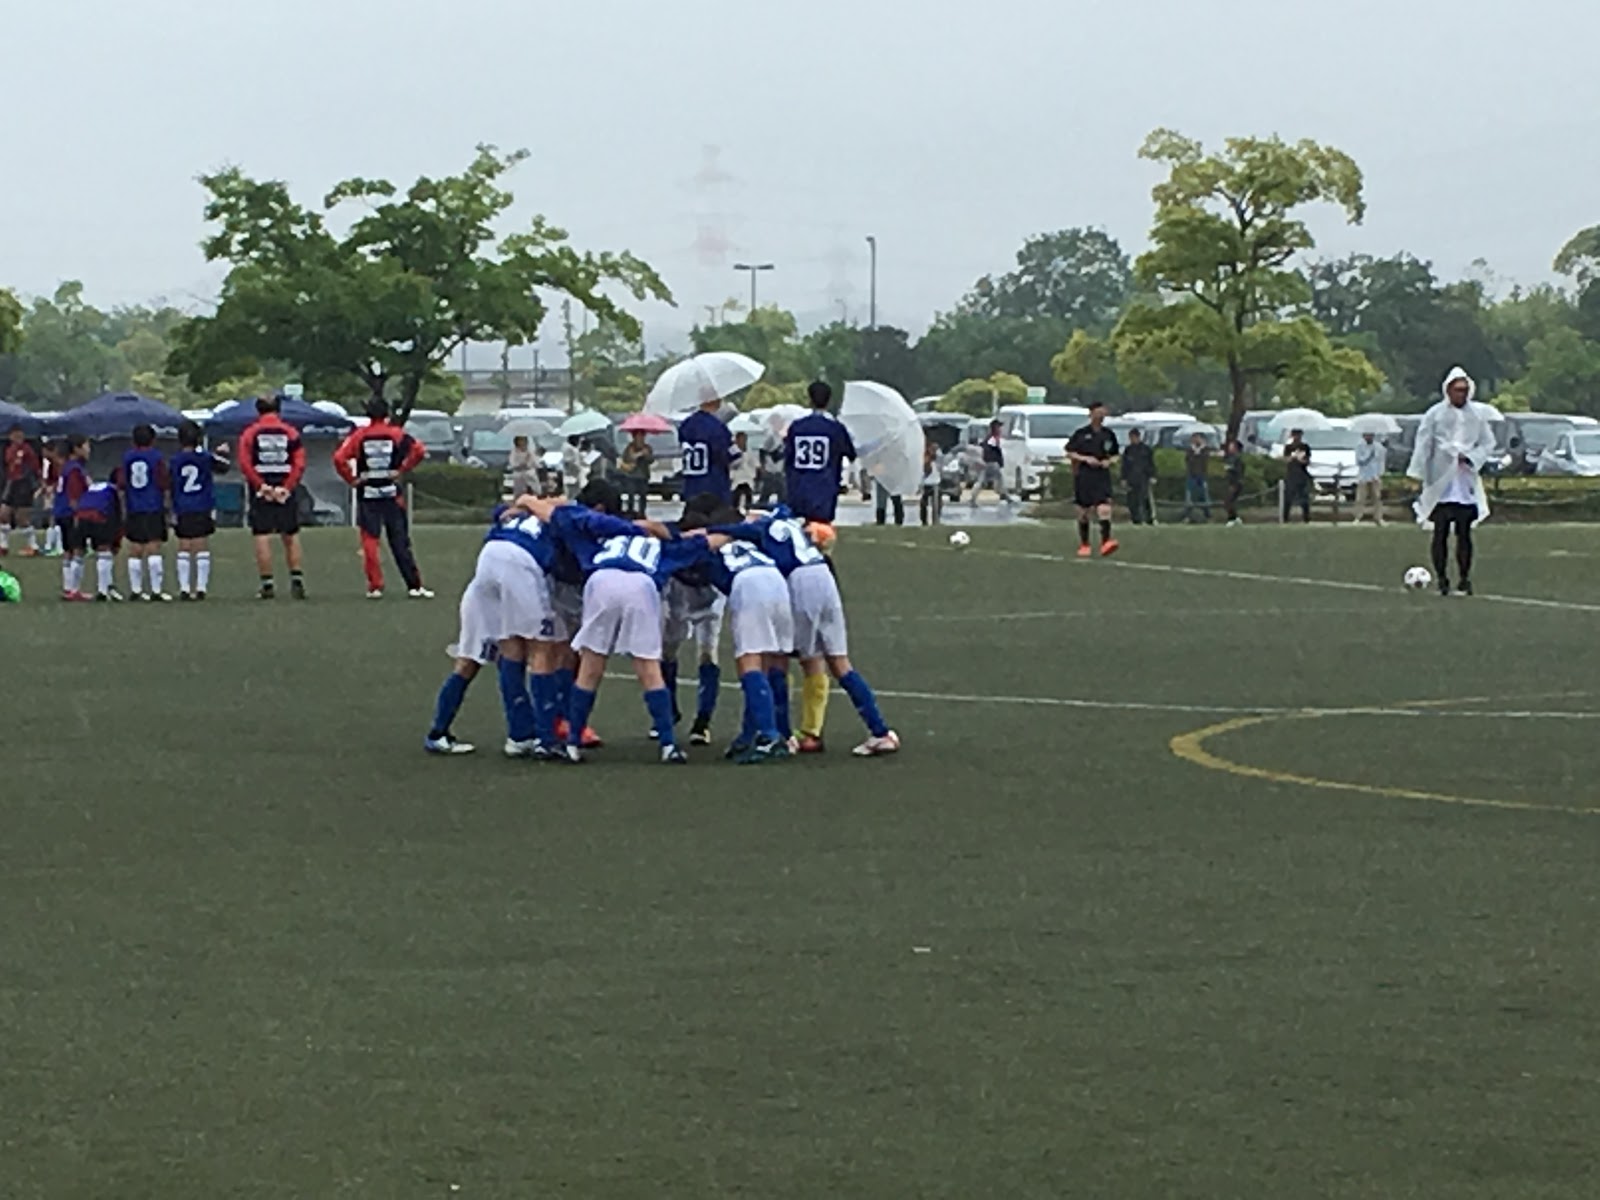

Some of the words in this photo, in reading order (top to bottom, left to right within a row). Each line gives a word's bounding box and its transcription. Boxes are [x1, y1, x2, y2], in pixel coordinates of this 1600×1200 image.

[797, 438, 827, 467] 39
[131, 461, 148, 488] 8
[182, 465, 201, 492] 2
